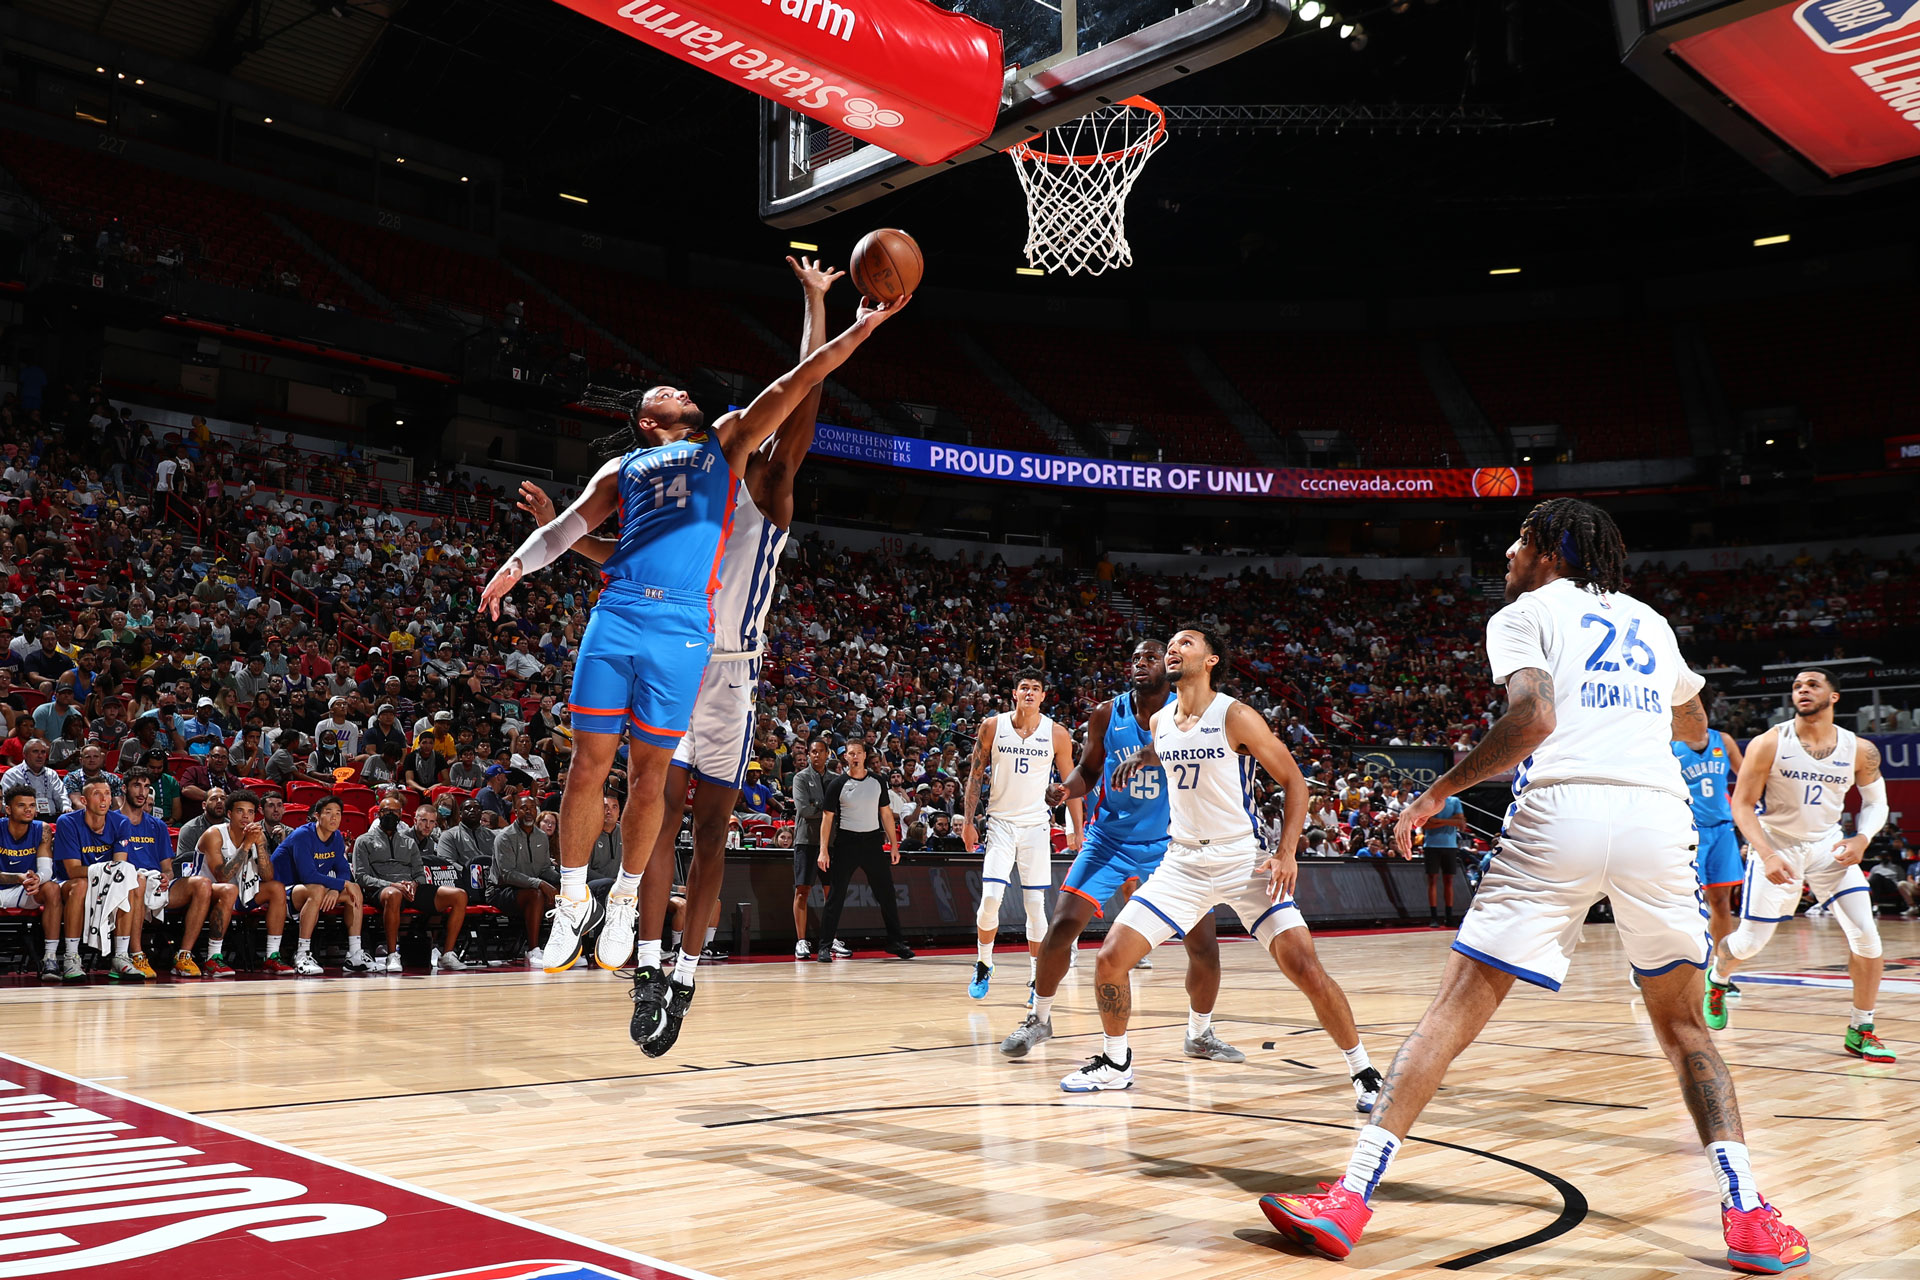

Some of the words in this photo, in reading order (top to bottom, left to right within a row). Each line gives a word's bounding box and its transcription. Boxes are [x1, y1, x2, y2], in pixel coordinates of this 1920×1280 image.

[98, 134, 128, 155] 227
[377, 211, 401, 231] 228
[581, 233, 602, 249] 229
[240, 354, 272, 373] 117
[818, 428, 911, 451] COMPREHENSIVE
[818, 440, 862, 456] CANCER
[865, 447, 911, 463] CENTERS
[626, 449, 716, 484] THUNDER
[930, 446, 1014, 476] PROUD
[1020, 457, 1163, 489] SUPPORTER
[1168, 469, 1200, 490] OF
[1207, 471, 1274, 493] UNLV
[649, 473, 692, 508] 14
[1301, 476, 1434, 491] cccnevada.com
[881, 536, 903, 553] 119
[645, 588, 664, 599] OKC
[1580, 612, 1656, 675] 26
[1875, 667, 1907, 678] ULTRA
[1580, 681, 1663, 714] MORALES
[997, 745, 1049, 757] WARRIORS
[1159, 747, 1225, 762] WARRIORS
[1014, 757, 1029, 774] 15
[1130, 769, 1160, 800] 25
[1173, 763, 1201, 790] 27
[1779, 768, 1848, 785] WARRIORS
[1701, 777, 1715, 798] 6
[1803, 784, 1823, 806] 12
